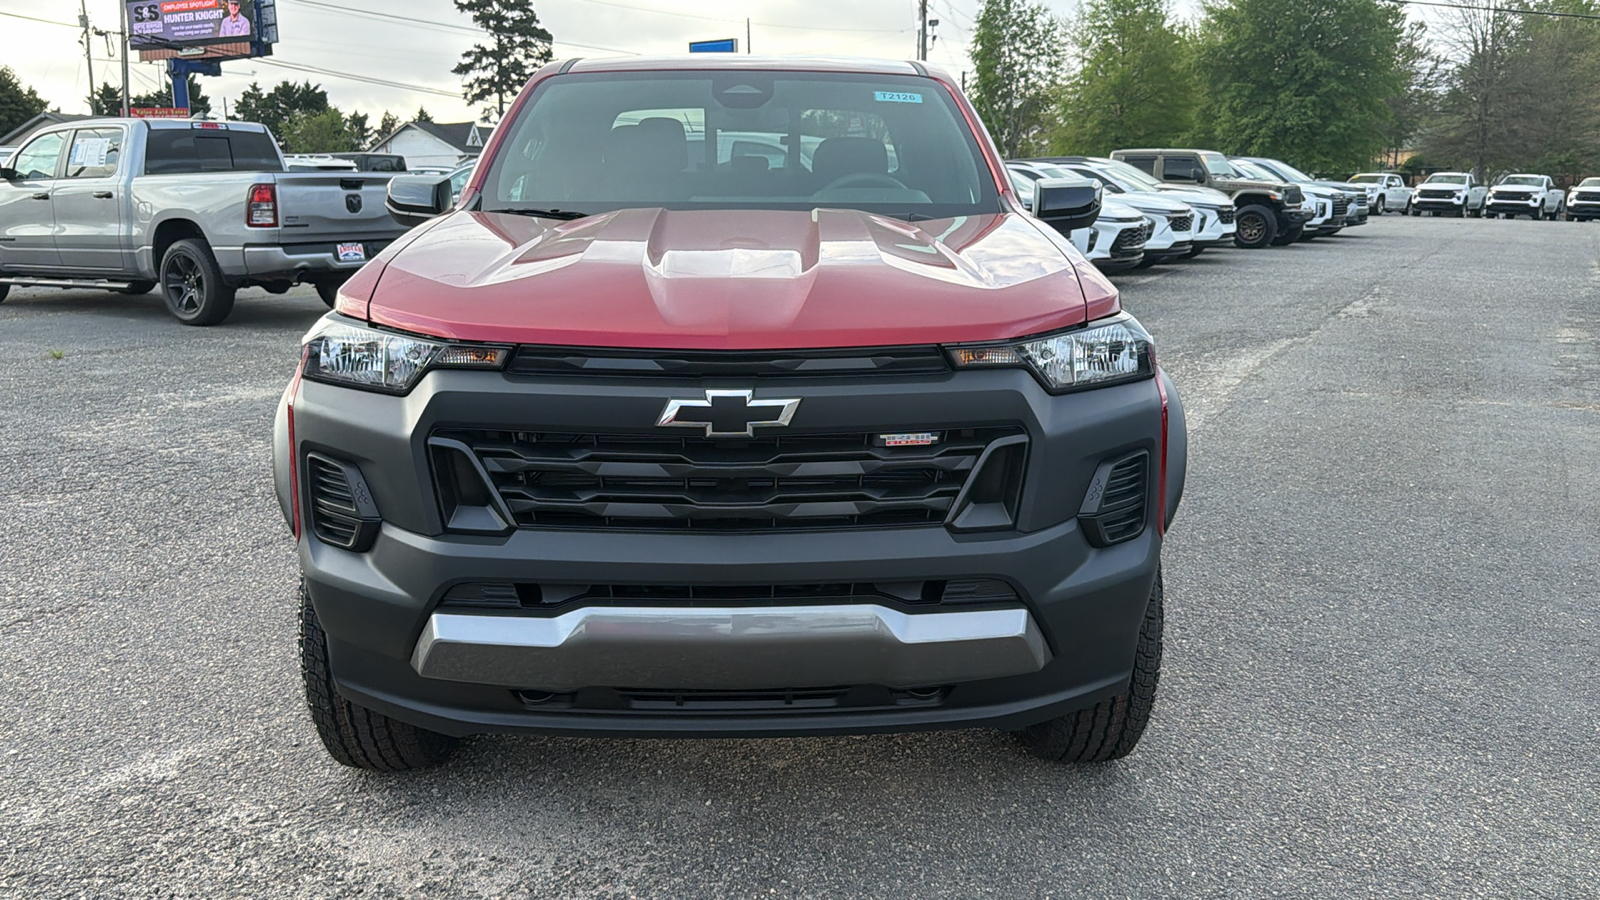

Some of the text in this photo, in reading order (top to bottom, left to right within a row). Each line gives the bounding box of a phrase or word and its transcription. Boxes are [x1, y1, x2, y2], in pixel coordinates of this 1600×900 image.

[134, 5, 159, 22] S&S
[164, 9, 223, 24] HUNTER KNIGHT
[881, 93, 916, 101] T2126
